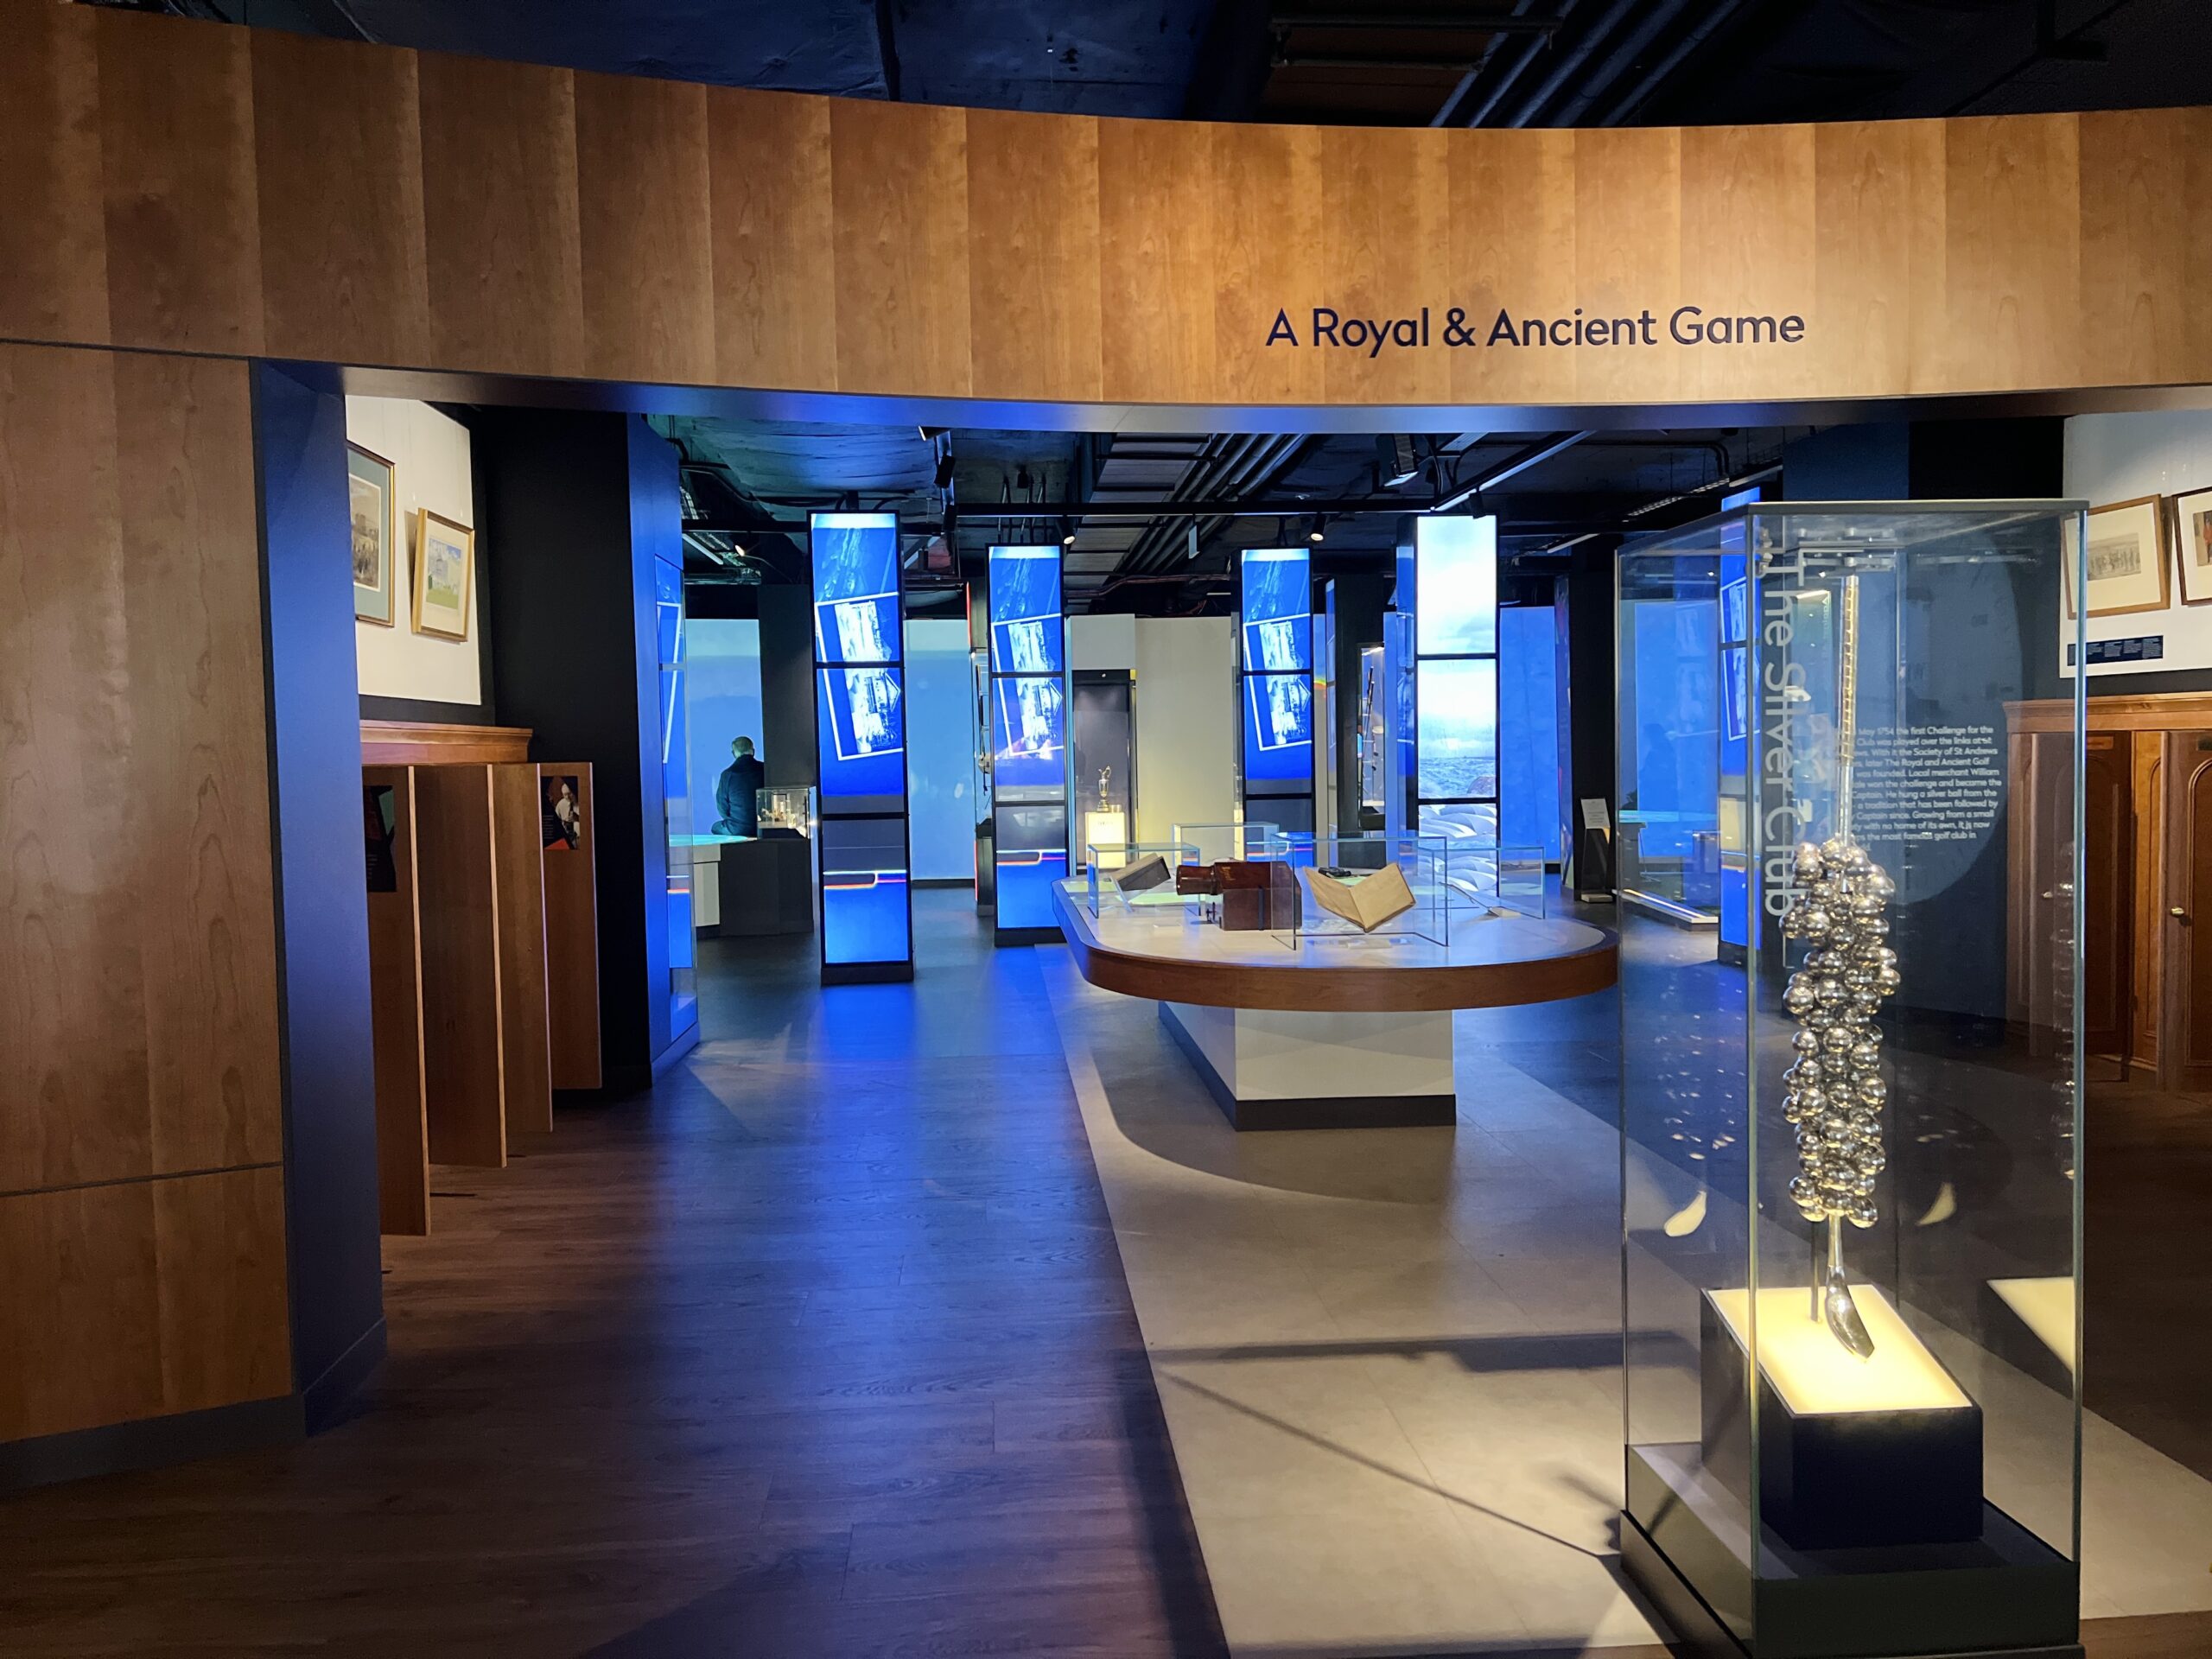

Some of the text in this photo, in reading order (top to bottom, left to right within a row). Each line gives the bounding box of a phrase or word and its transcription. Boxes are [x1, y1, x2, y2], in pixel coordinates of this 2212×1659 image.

[1266, 305, 1805, 358] A Royal & Ancient Game
[1764, 547, 1808, 916] The Silver Club
